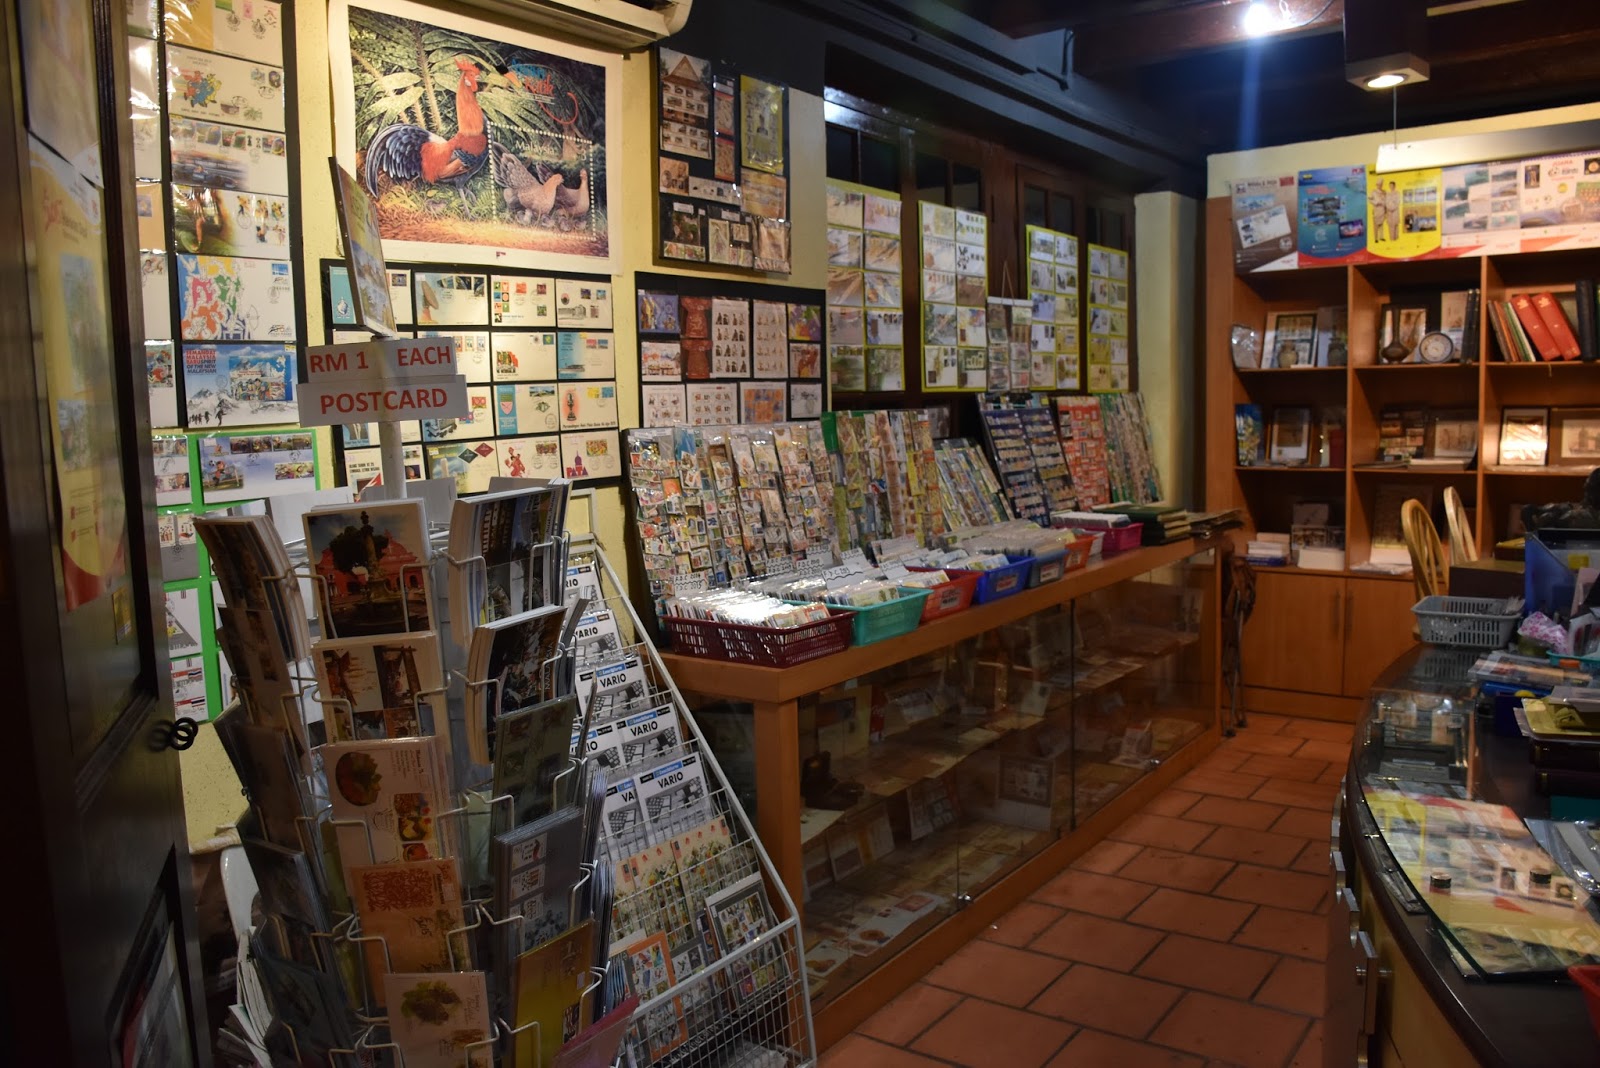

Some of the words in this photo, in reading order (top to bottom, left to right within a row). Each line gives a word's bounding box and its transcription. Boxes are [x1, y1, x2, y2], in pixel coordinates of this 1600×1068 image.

[515, 140, 555, 155] Malaysia
[310, 352, 348, 373] RM
[356, 351, 369, 370] 1
[397, 345, 451, 367] EACH
[320, 388, 448, 415] POSTCARD
[566, 466, 589, 477] PATA
[600, 673, 627, 688] VARIO
[630, 721, 658, 737] VARIO
[657, 771, 684, 789] VARIO
